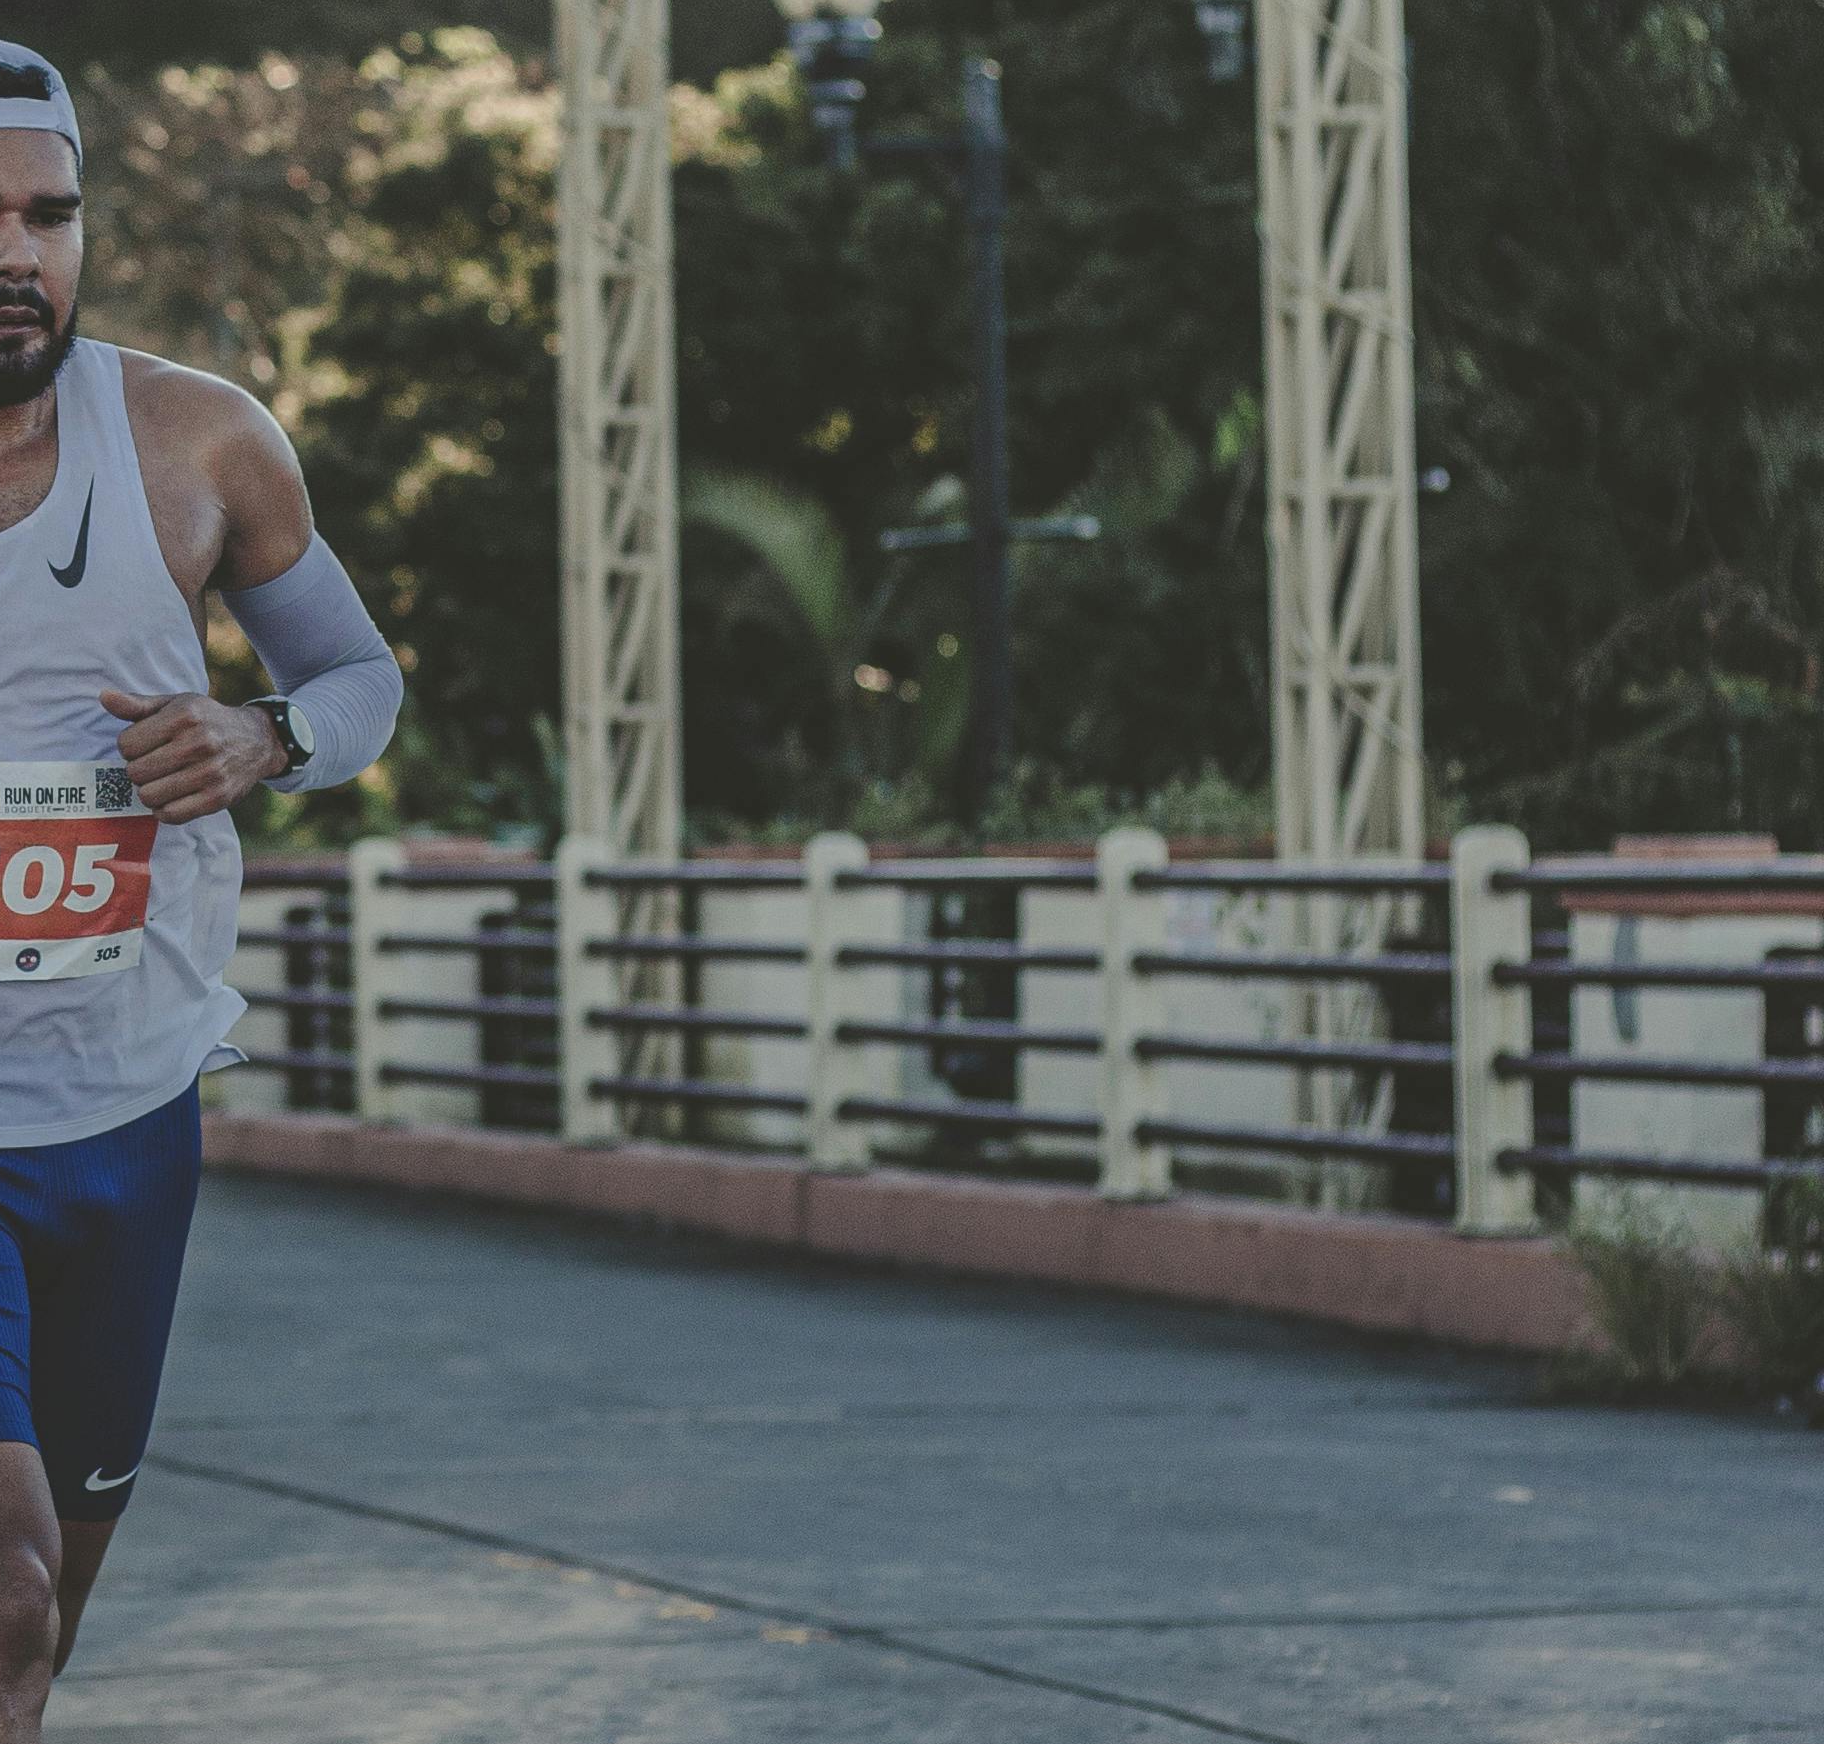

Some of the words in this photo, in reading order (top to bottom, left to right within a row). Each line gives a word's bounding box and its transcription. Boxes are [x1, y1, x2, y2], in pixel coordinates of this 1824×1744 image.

[4, 787, 32, 805] RUN
[36, 787, 54, 805] ON
[57, 786, 87, 804] FIRE
[4, 805, 51, 814] BOQUETE
[66, 804, 91, 813] 2021
[93, 945, 122, 963] 305
